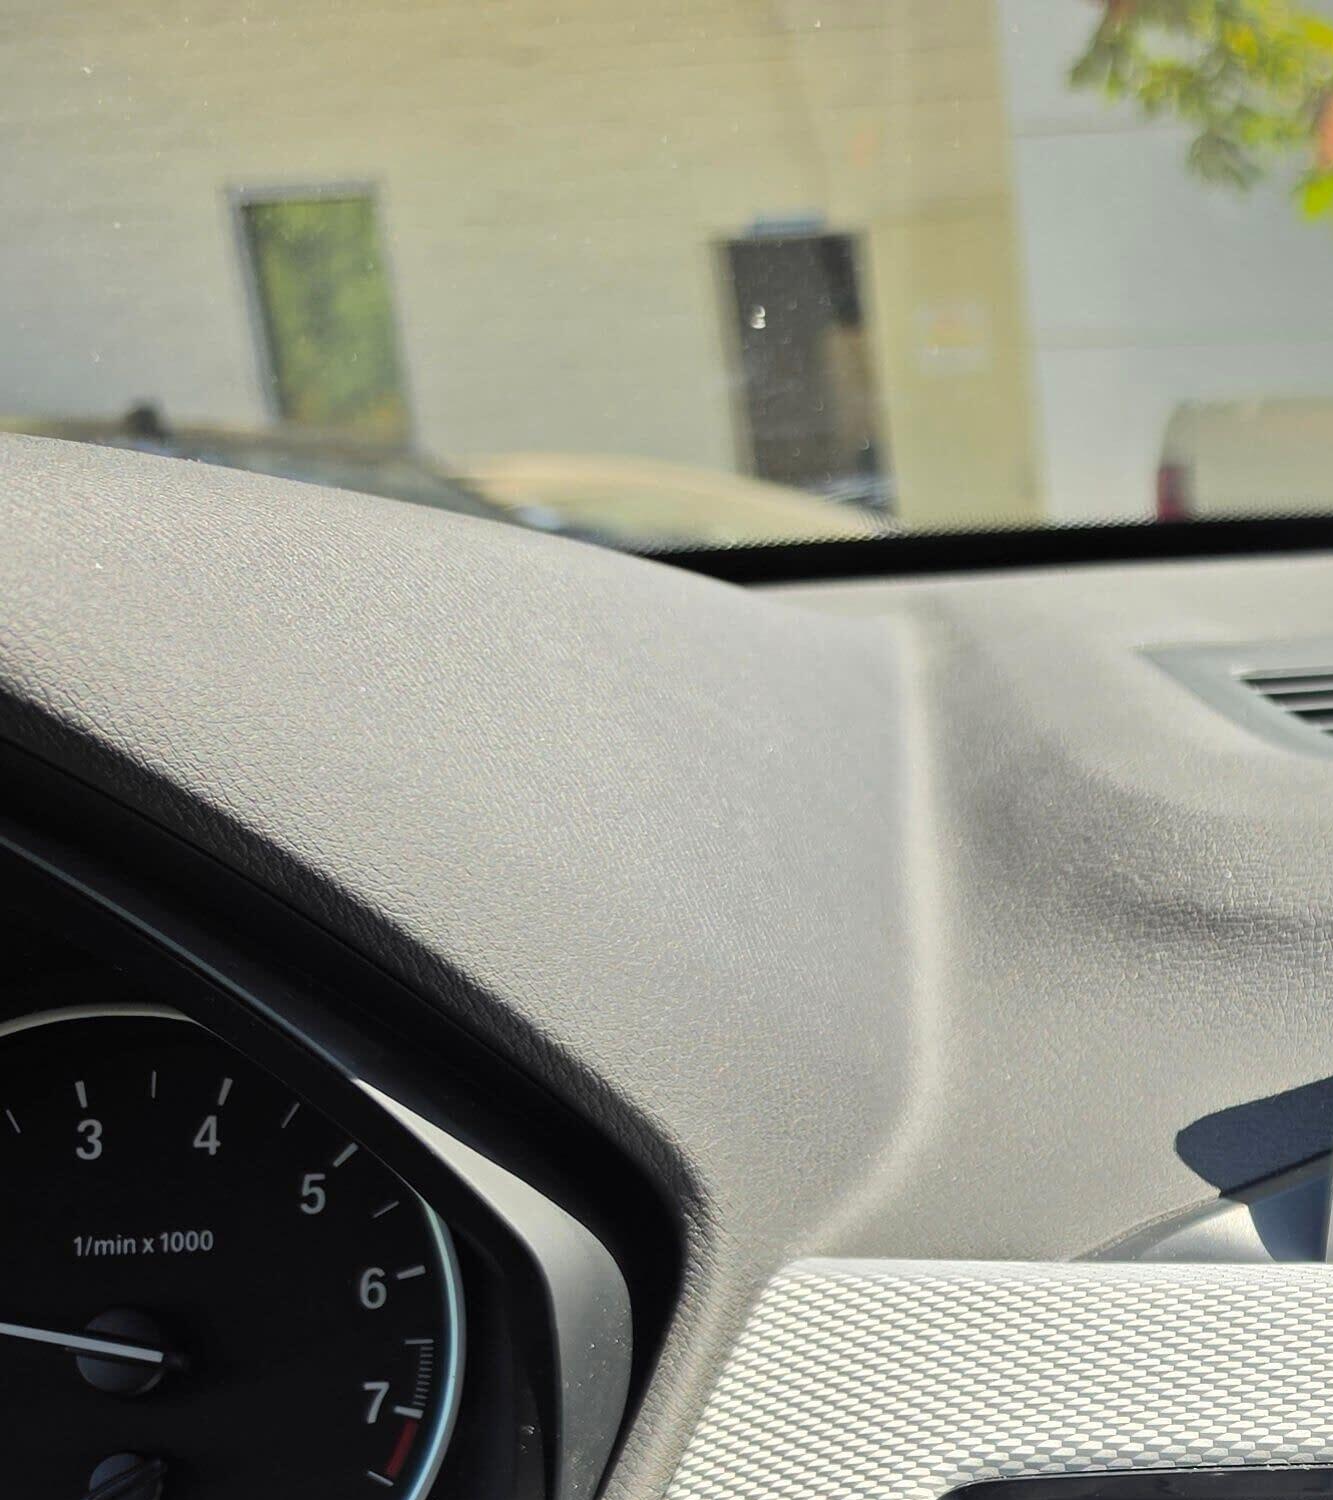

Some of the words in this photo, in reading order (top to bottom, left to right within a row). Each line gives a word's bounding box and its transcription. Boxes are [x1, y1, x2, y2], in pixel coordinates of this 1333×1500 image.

[75, 1119, 104, 1162] 3
[192, 1113, 223, 1157] 4
[299, 1173, 326, 1215] 5
[72, 1233, 137, 1258] 1/min
[141, 1238, 157, 1255] x
[159, 1229, 215, 1254] 1000
[360, 1267, 387, 1309] 6
[362, 1381, 391, 1425] 7
